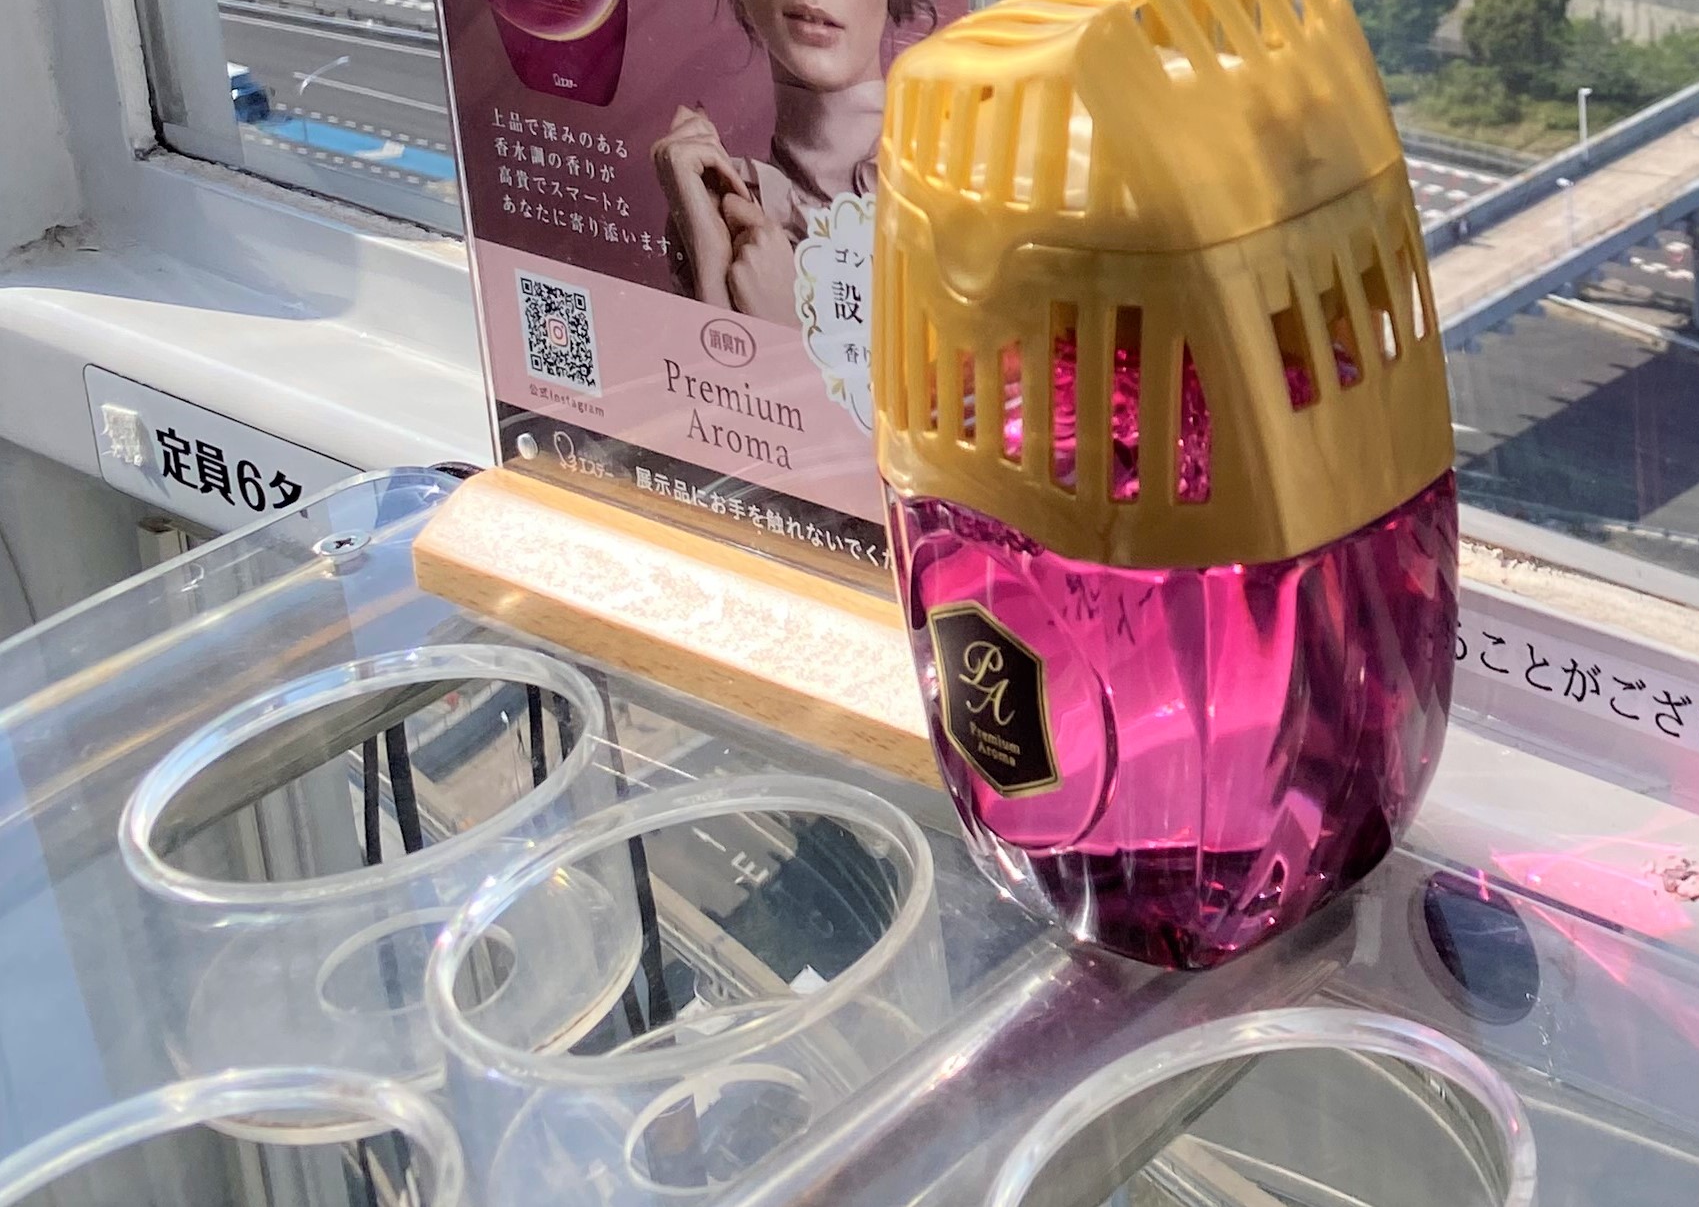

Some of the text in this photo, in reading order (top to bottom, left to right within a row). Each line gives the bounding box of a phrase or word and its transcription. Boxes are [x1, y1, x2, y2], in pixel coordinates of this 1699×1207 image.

[490, 106, 629, 159] 上品で深みのある
[494, 136, 616, 184] 香水調の香りが
[498, 165, 631, 218] 高貴でスマートな
[502, 193, 684, 261] あなたに寄り添います。
[834, 248, 873, 269] ゴン
[663, 358, 806, 433] Premium
[685, 407, 794, 471] Aroma
[969, 720, 1021, 756] Premium
[977, 742, 1017, 768] Aroma
